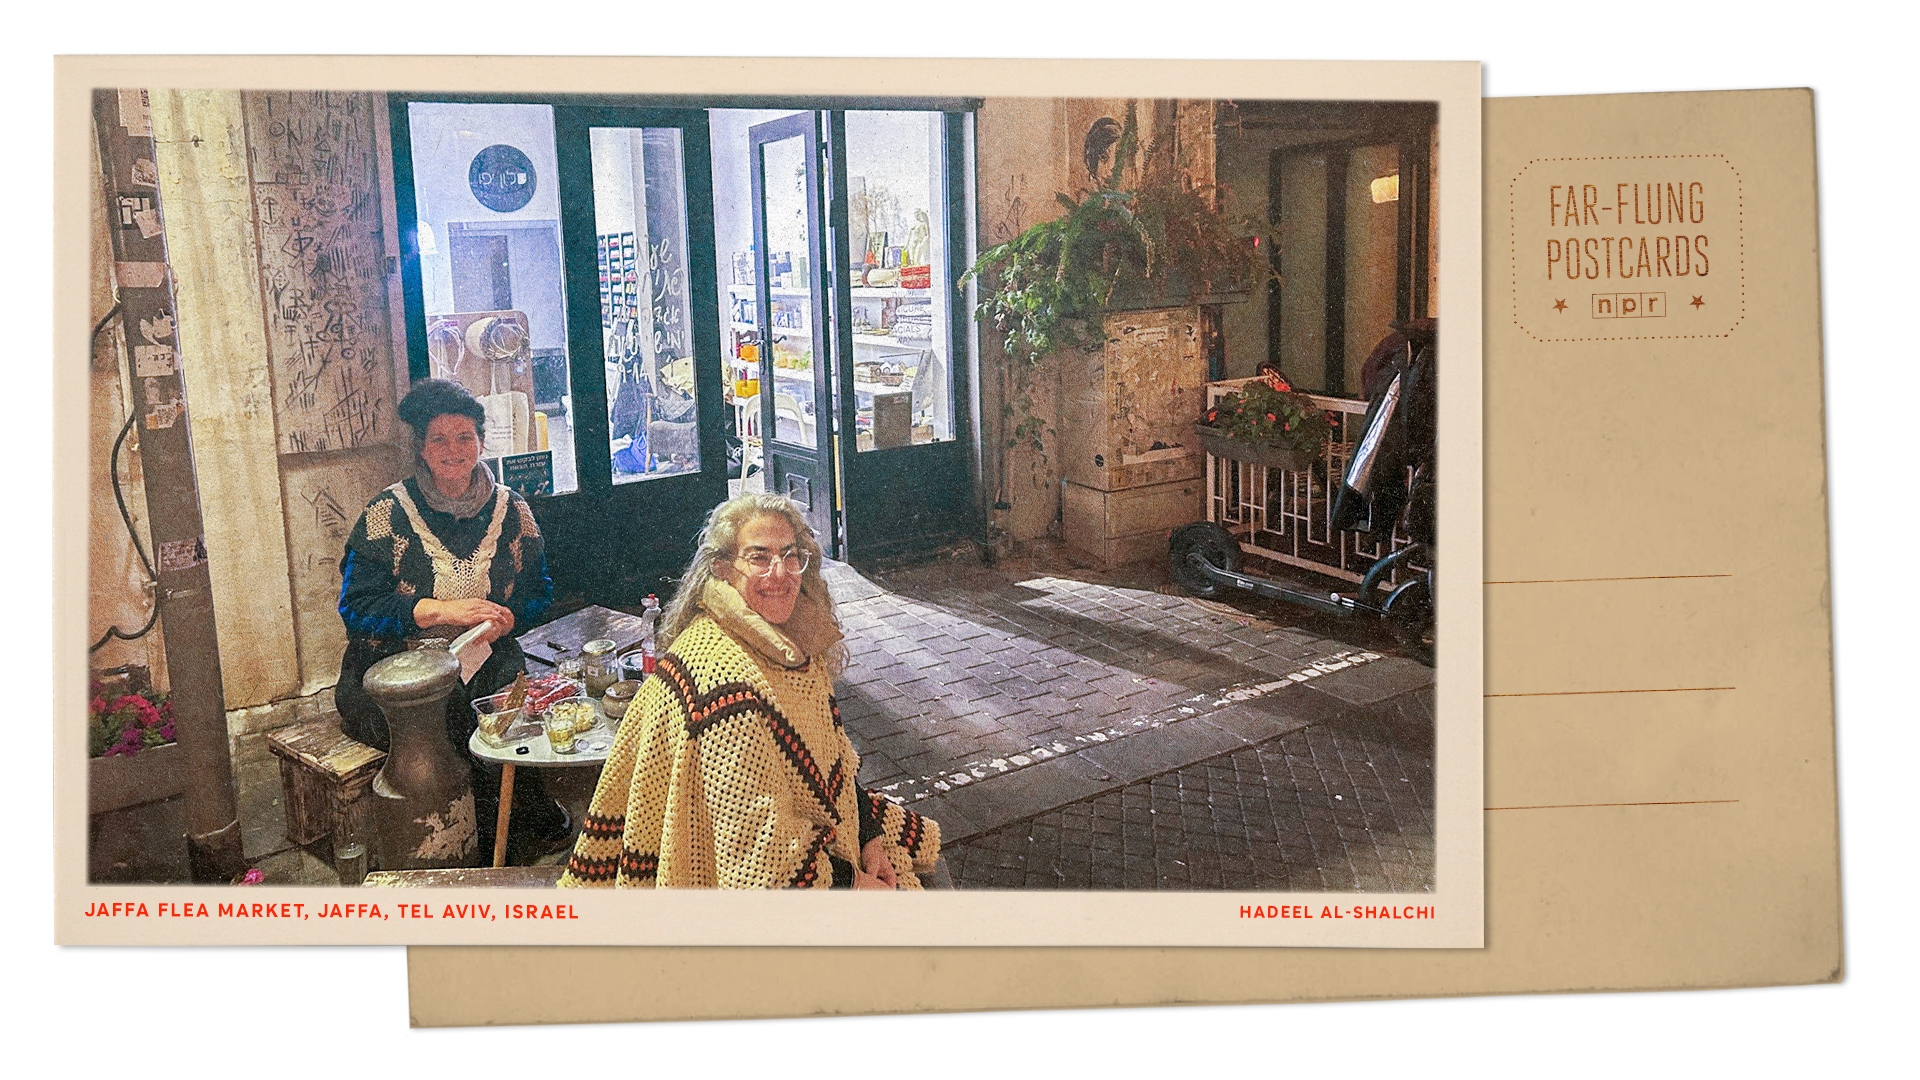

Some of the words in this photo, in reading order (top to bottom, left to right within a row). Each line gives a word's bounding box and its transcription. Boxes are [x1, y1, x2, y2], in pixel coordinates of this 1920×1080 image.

[1550, 181, 1705, 227] FAR-FLUNG
[1547, 234, 1710, 280] POSTCARDS
[1596, 296, 1659, 316] npr
